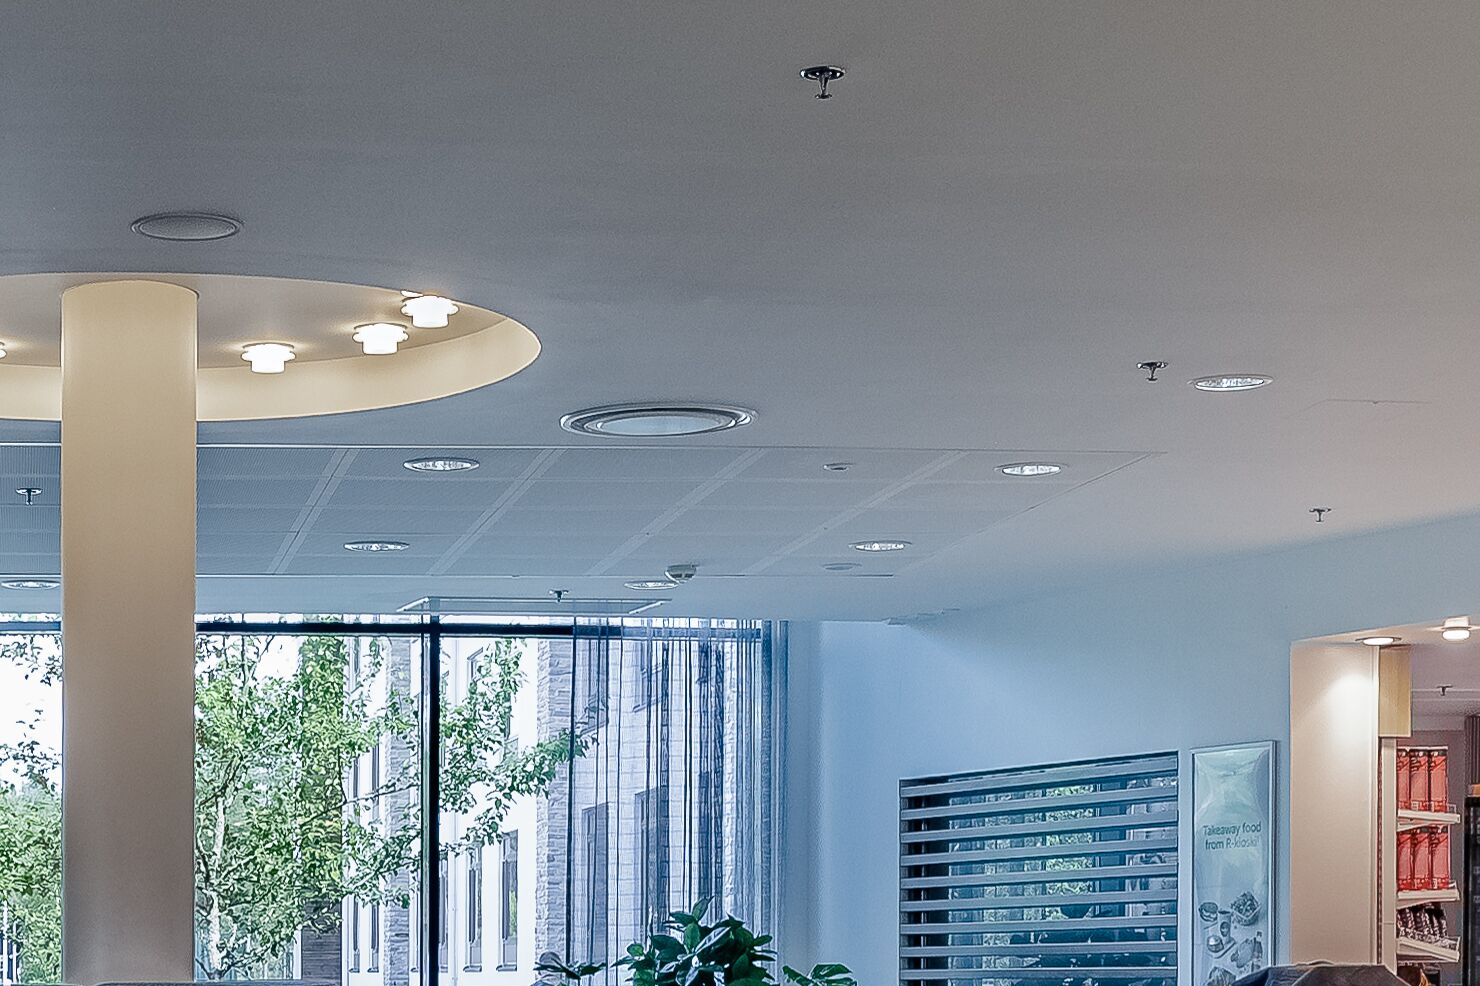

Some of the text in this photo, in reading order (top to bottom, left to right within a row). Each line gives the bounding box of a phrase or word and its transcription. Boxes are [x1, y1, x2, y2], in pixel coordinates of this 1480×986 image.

[1202, 821, 1262, 837] Takeaway food
[1205, 839, 1225, 850] from
